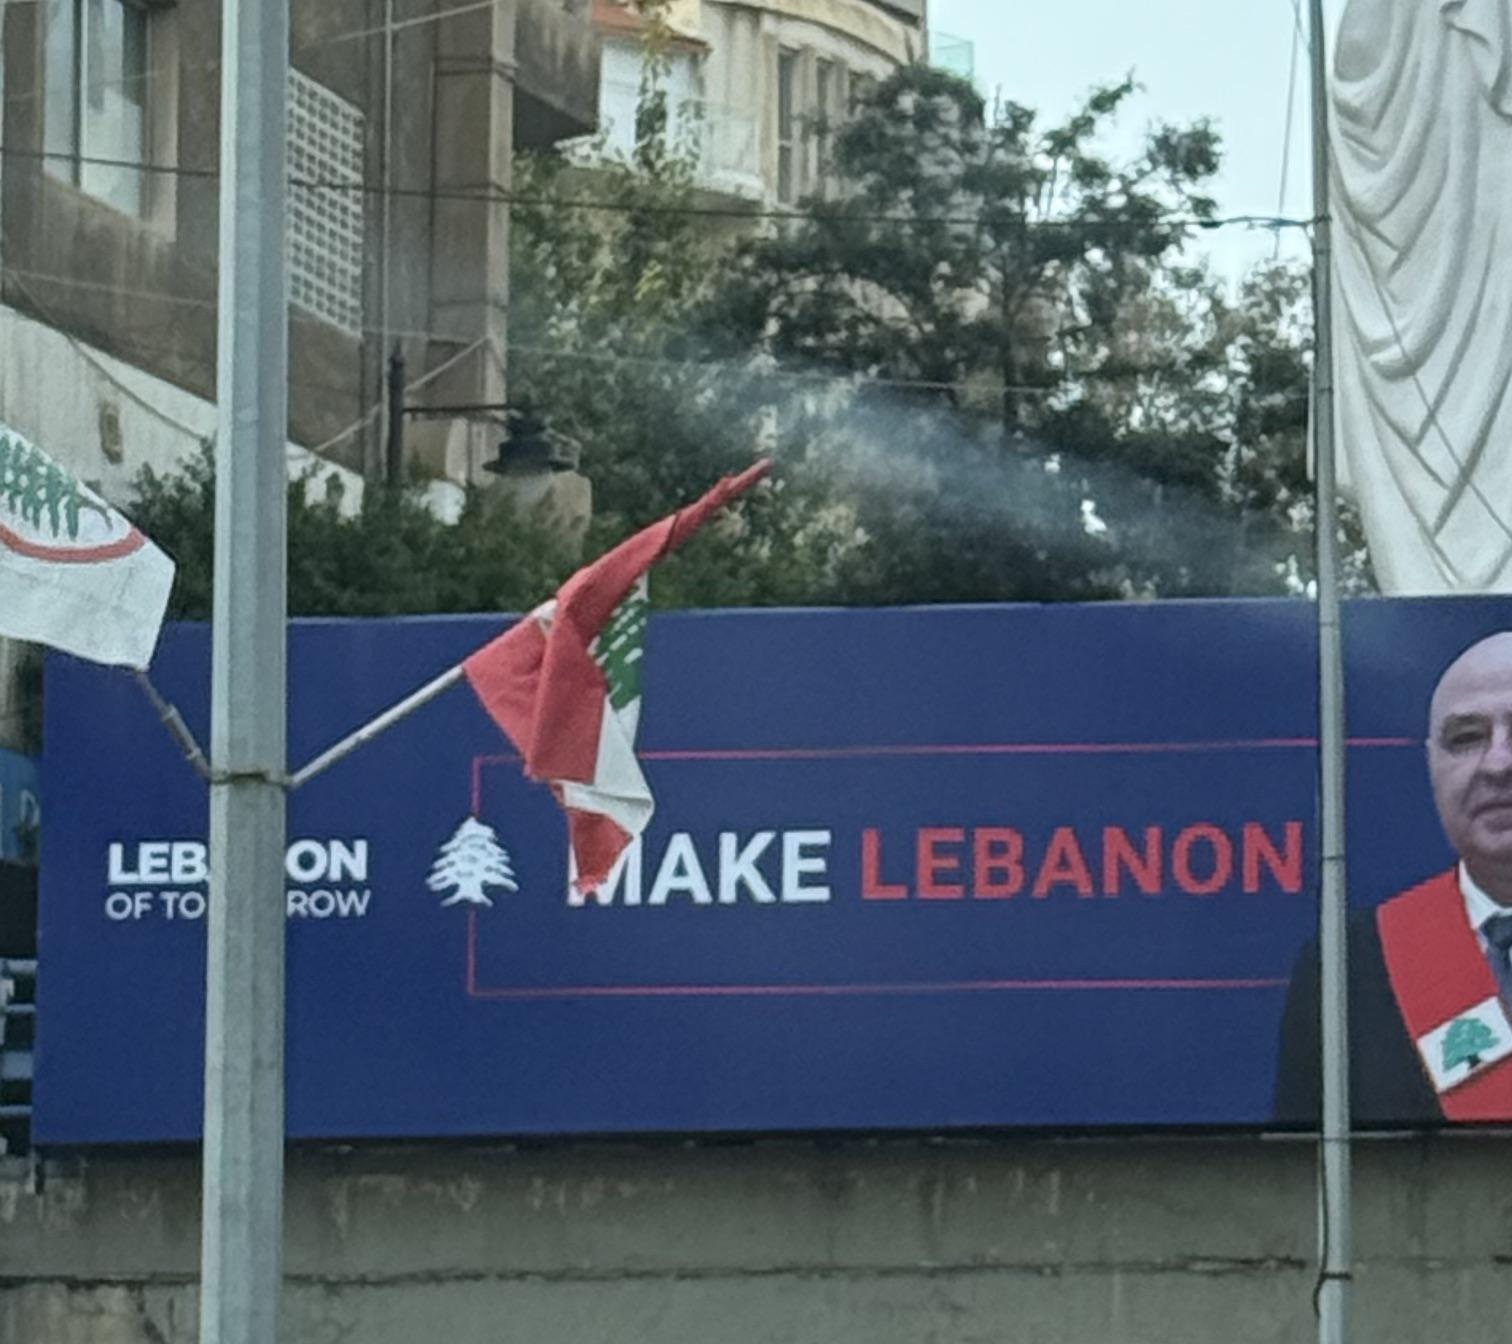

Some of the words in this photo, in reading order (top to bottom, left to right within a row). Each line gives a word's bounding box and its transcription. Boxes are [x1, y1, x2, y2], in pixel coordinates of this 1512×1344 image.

[107, 840, 369, 885] LEBON
[860, 821, 1303, 901] LEBANON
[105, 891, 153, 920] OF
[160, 889, 372, 920] TOROW
